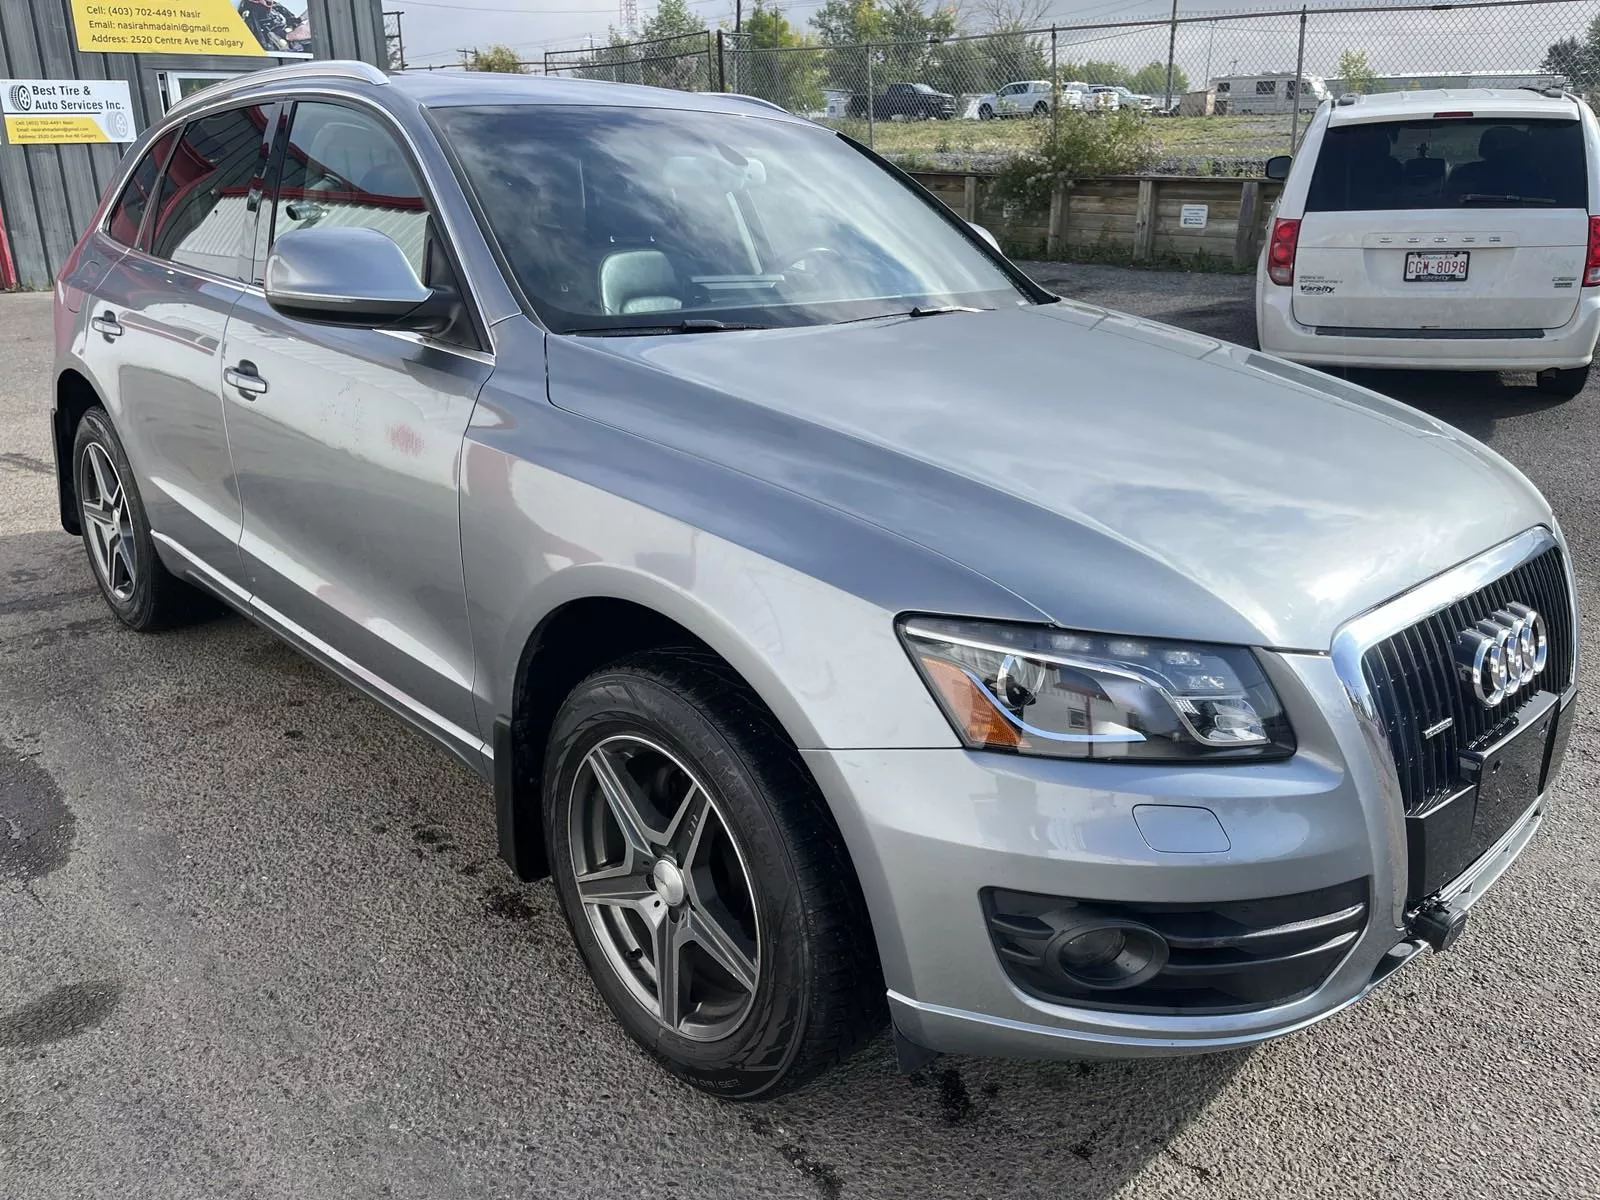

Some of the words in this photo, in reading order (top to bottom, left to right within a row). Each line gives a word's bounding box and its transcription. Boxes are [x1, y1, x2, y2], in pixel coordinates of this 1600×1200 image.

[86, 6, 106, 15] Cell:
[108, 6, 133, 17] (403)
[135, 8, 177, 17] 702-4491
[180, 10, 201, 18] Nasir
[89, 20, 115, 29] Email:
[91, 34, 129, 43] Address:
[130, 35, 153, 44] 2520
[154, 36, 182, 45] Centre
[184, 37, 199, 46] Ave
[201, 38, 213, 46] NE
[214, 38, 244, 48] Calgary
[32, 86, 56, 95] Best
[59, 86, 80, 95] Tire
[83, 86, 91, 96] &
[35, 100, 58, 110] Auto
[61, 100, 104, 110] Services
[106, 100, 125, 110] Inc.
[1408, 261, 1466, 274] CGM-8098
